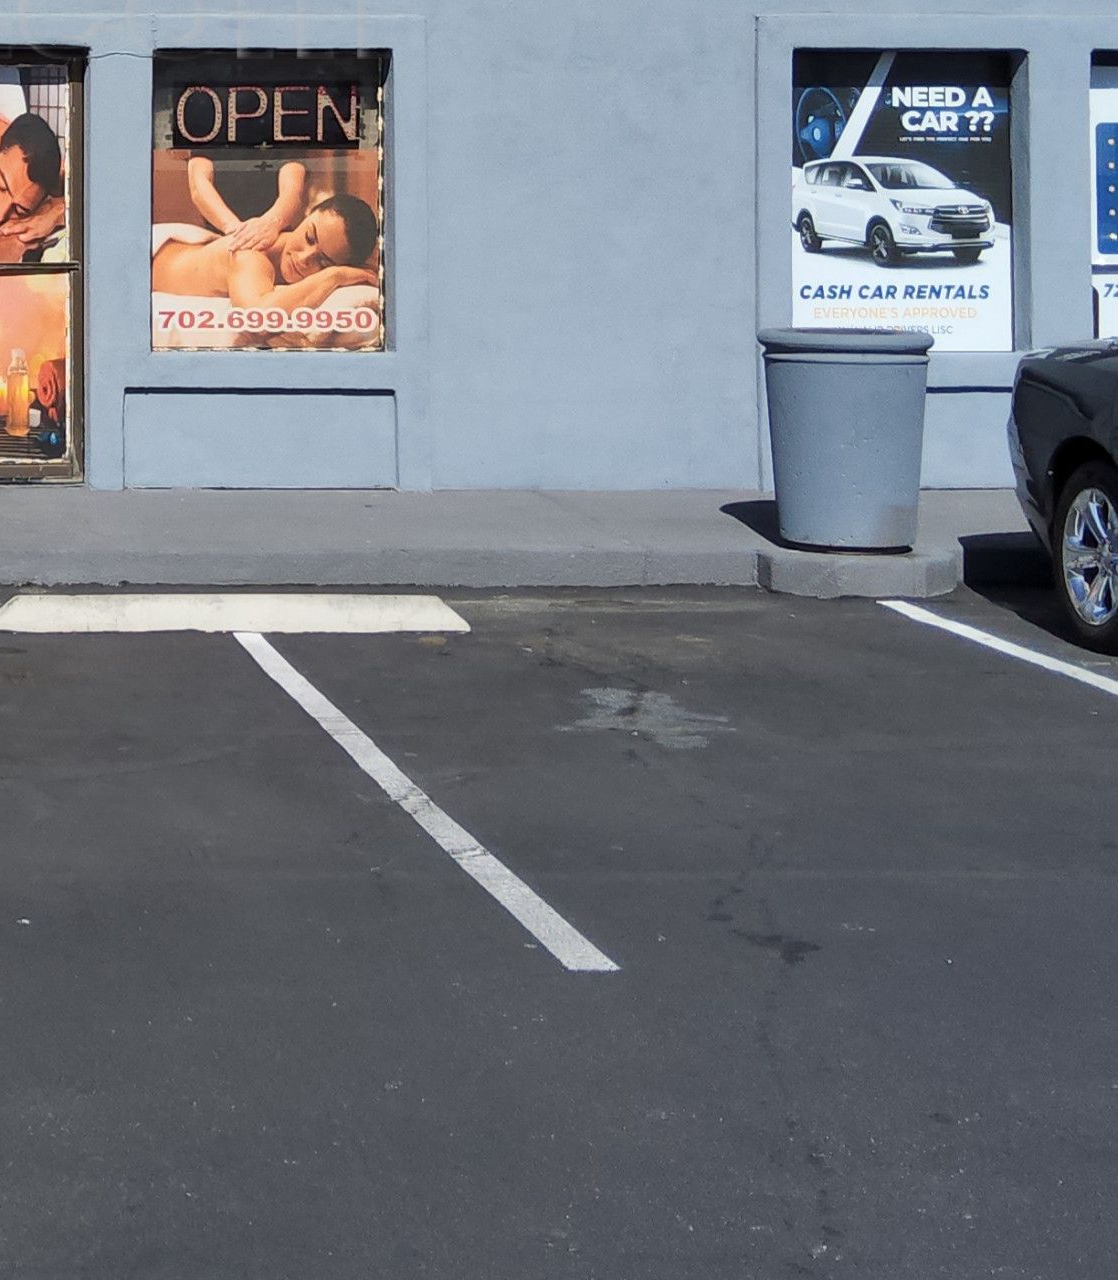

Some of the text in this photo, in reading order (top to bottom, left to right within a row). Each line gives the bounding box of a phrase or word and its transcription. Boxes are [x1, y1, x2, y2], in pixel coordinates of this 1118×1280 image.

[891, 86, 994, 108] NEED A
[176, 85, 360, 142] OPEN
[901, 110, 995, 131] CAR ??
[799, 285, 990, 300] CASH CAR RENTALS
[158, 311, 373, 329] 702.699.9950
[813, 307, 978, 319] EVERYONE'S APPROVED
